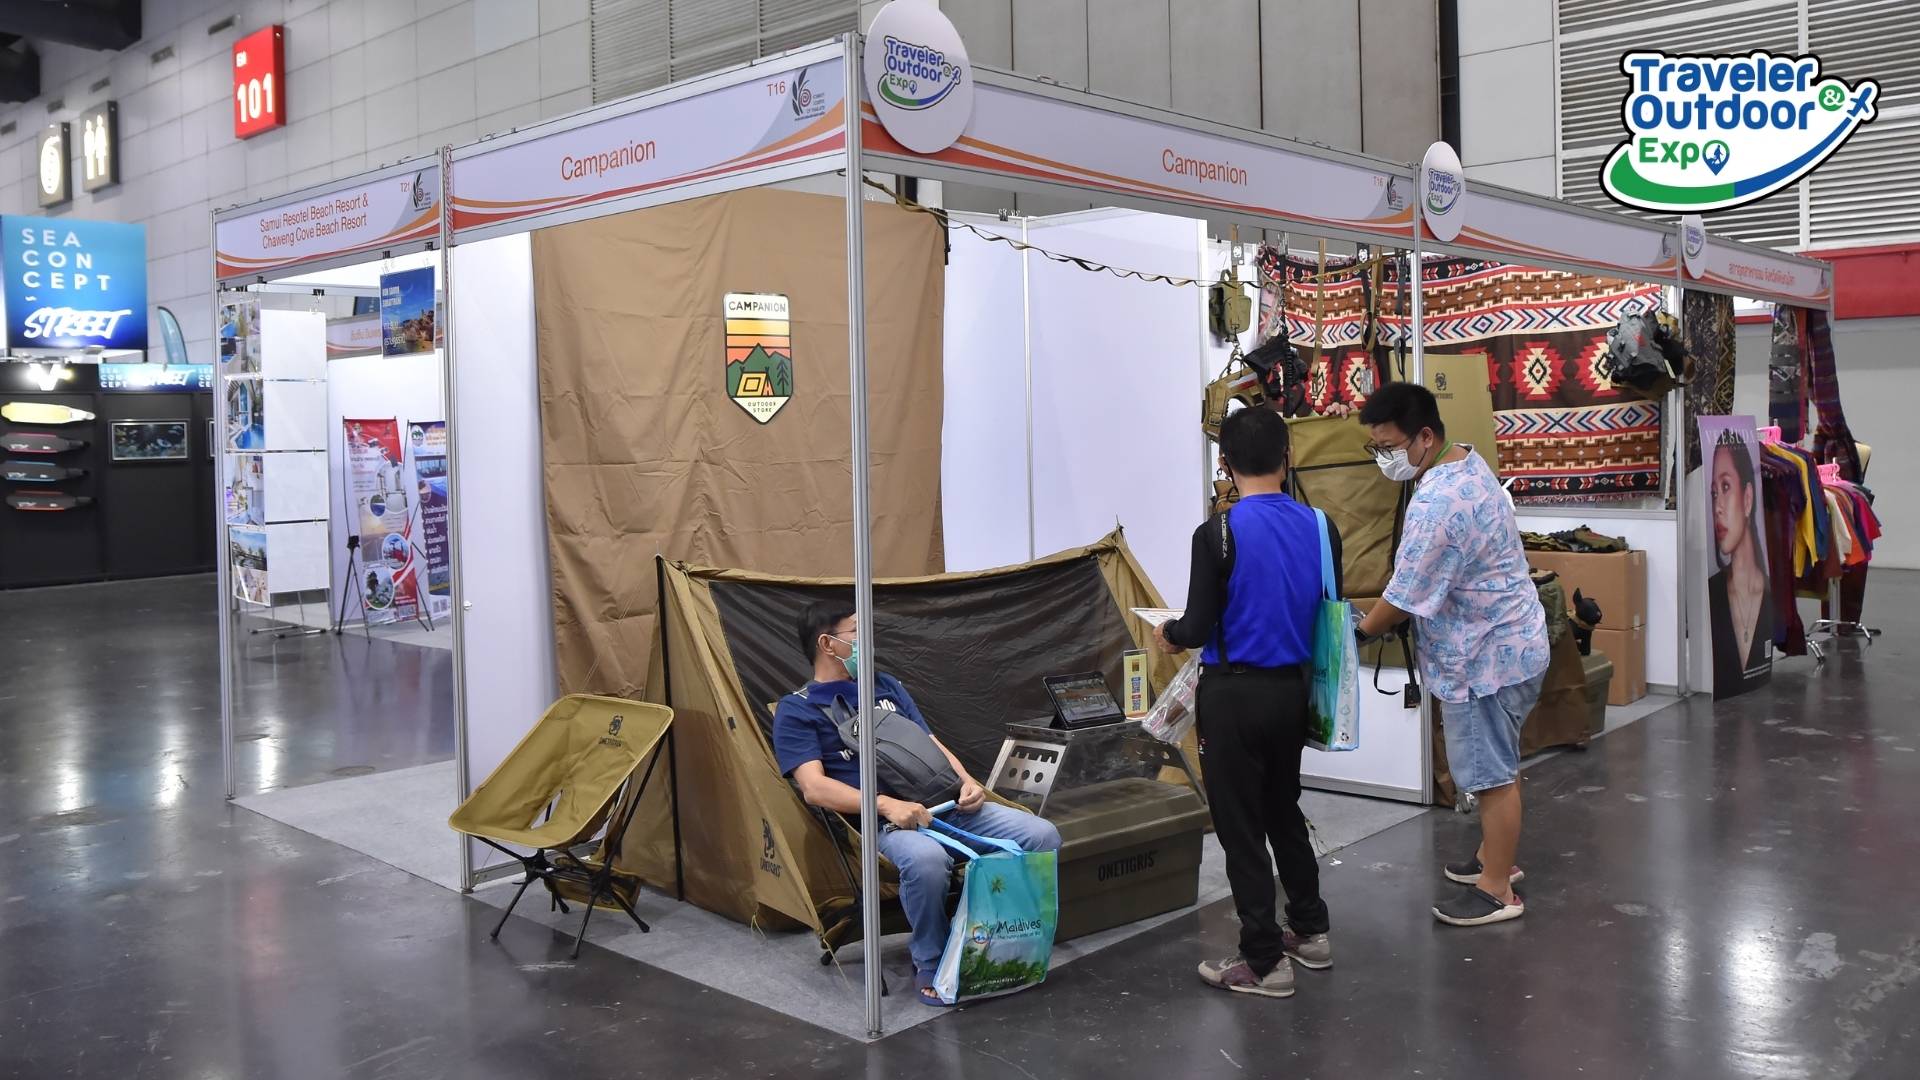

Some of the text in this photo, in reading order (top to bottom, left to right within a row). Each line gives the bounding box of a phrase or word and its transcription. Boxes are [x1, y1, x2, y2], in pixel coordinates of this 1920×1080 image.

[887, 40, 944, 67] Traveler
[887, 55, 943, 83] Outdoor
[237, 72, 273, 123] 101
[767, 81, 786, 96] T16
[561, 140, 656, 180] Campanion
[1162, 149, 1248, 186] Campanion
[260, 193, 369, 233] Samui Resotel Beach Resort &
[22, 228, 82, 248] SEA
[263, 212, 367, 249] Chaweng Cove Beach Resort
[22, 250, 93, 270] CON
[23, 271, 112, 291] CEPT
[728, 301, 786, 312] CAMPANION
[23, 306, 133, 339] STREET
[1097, 851, 1155, 882] ONETIGRIS
[996, 917, 1042, 934] Maldives
